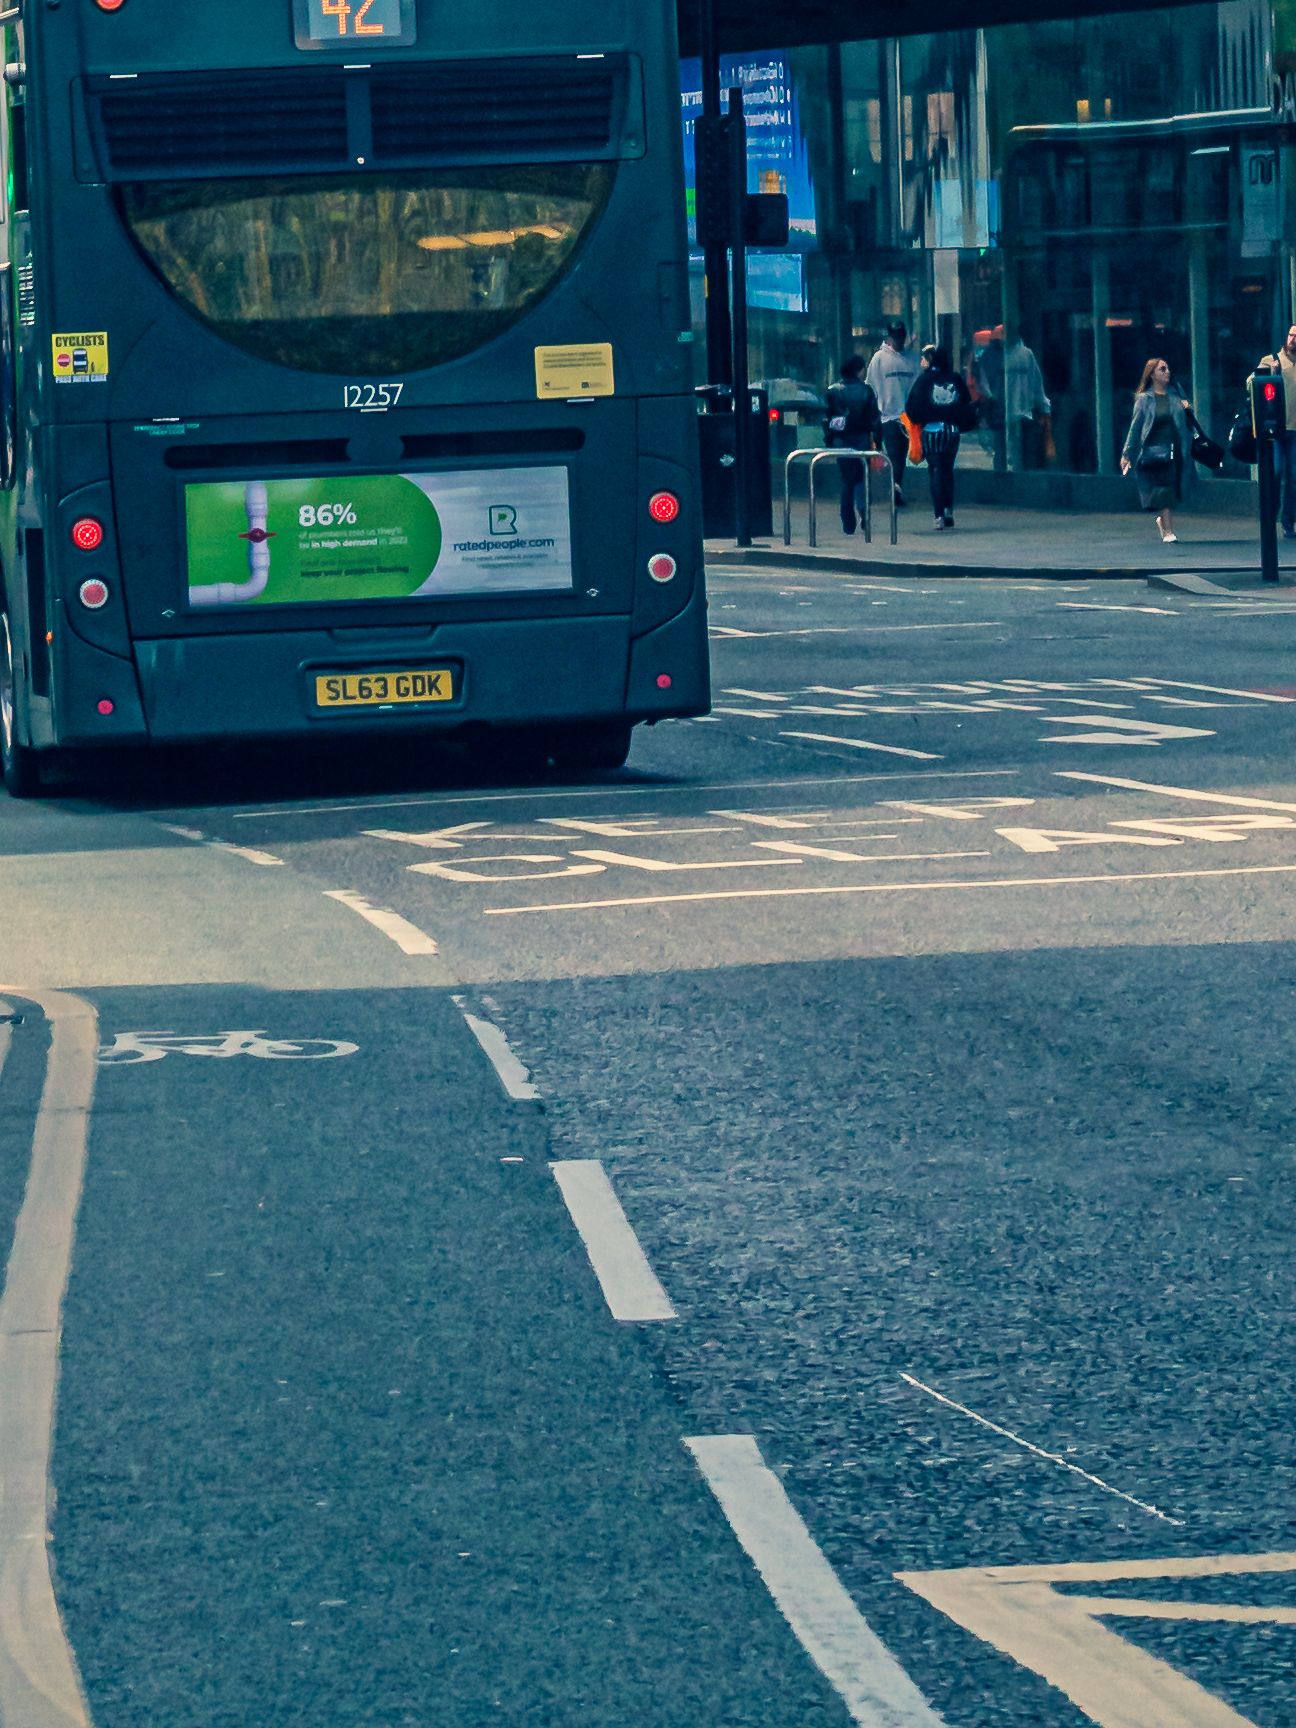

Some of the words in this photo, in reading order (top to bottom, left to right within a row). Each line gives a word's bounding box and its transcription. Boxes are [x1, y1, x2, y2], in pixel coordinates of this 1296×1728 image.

[55, 335, 105, 347] CYCLISTS
[344, 383, 404, 407] 12257
[298, 502, 357, 527] 86%
[321, 539, 341, 549] high
[342, 538, 378, 547] demand
[453, 538, 555, 552] ratedpeople.com
[326, 677, 389, 701] SL63
[396, 675, 442, 698] GDK
[362, 797, 1035, 850] KEEP
